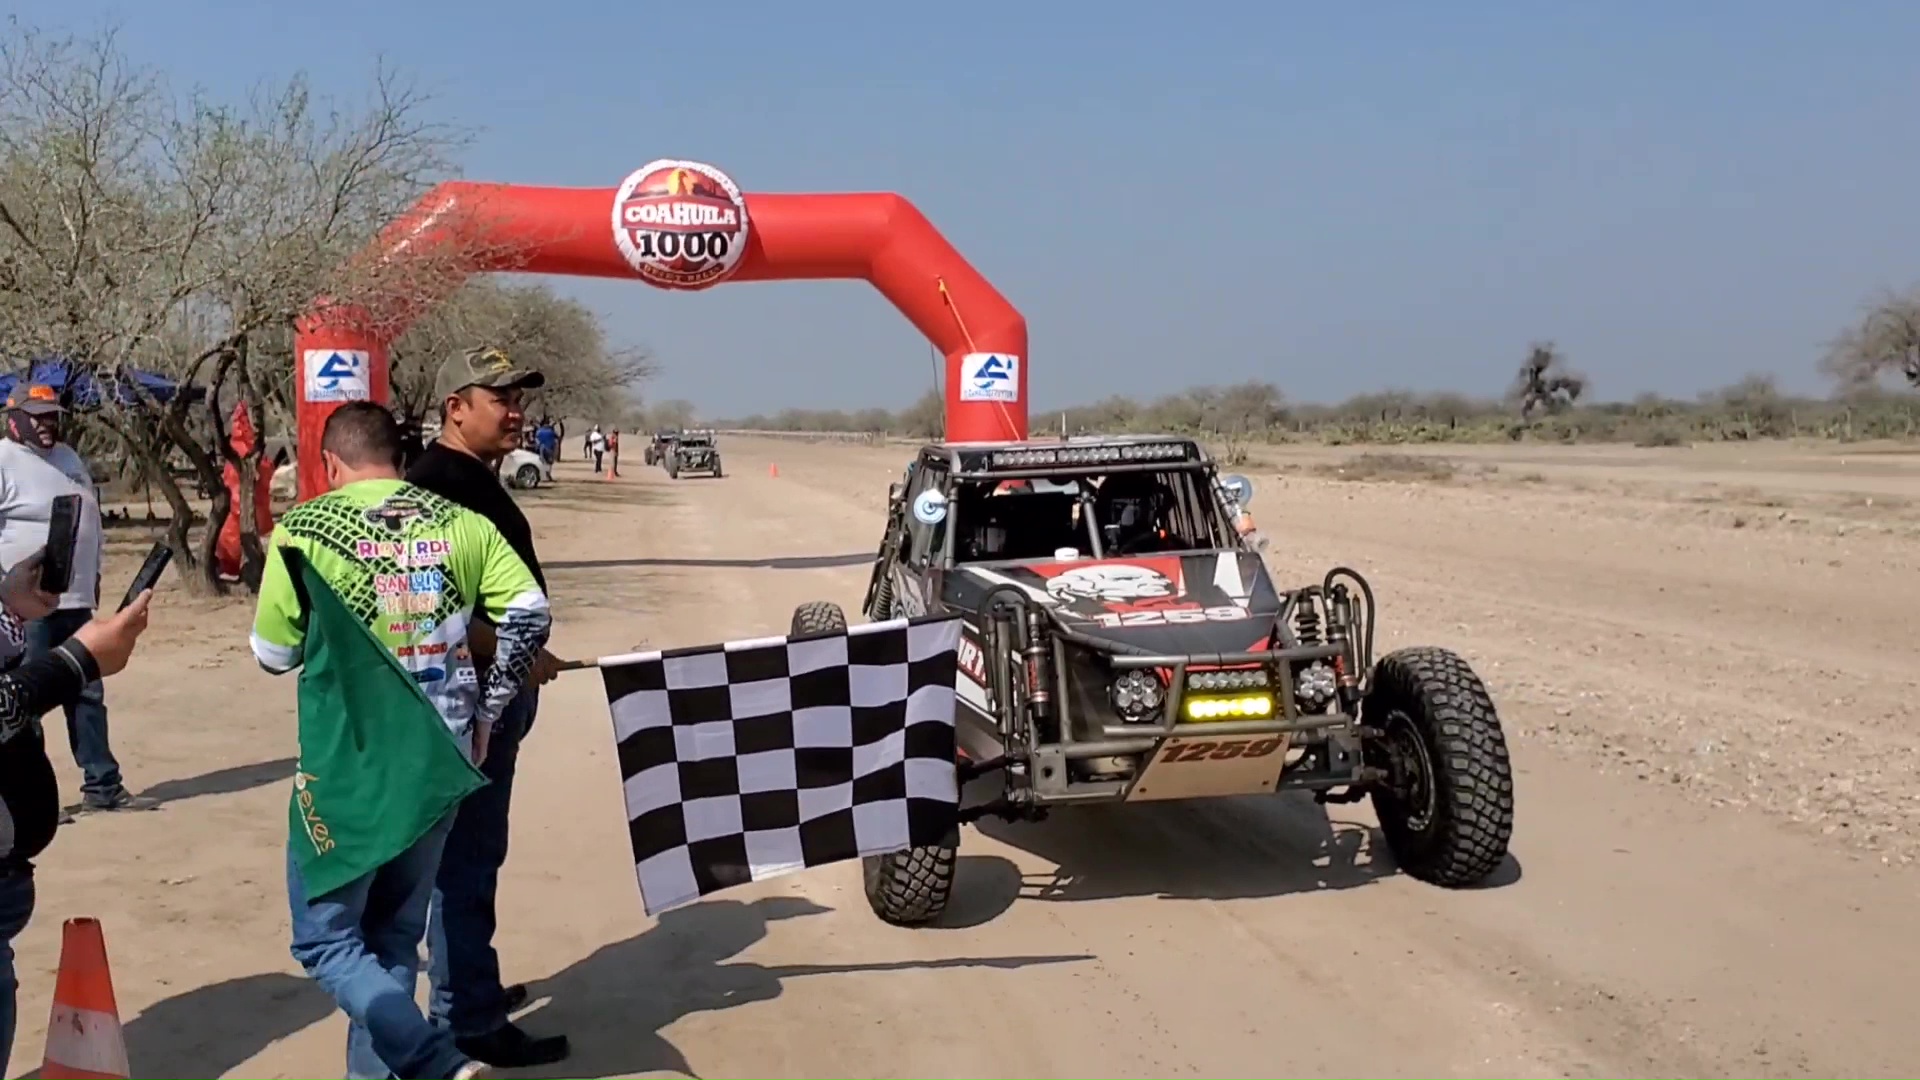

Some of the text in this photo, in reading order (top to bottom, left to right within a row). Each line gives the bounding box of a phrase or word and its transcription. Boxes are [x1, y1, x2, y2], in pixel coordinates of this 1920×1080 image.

[624, 202, 737, 226] COAHUILA
[640, 231, 729, 259] 1000
[375, 574, 408, 594] SAN
[1160, 738, 1282, 764] 1259
